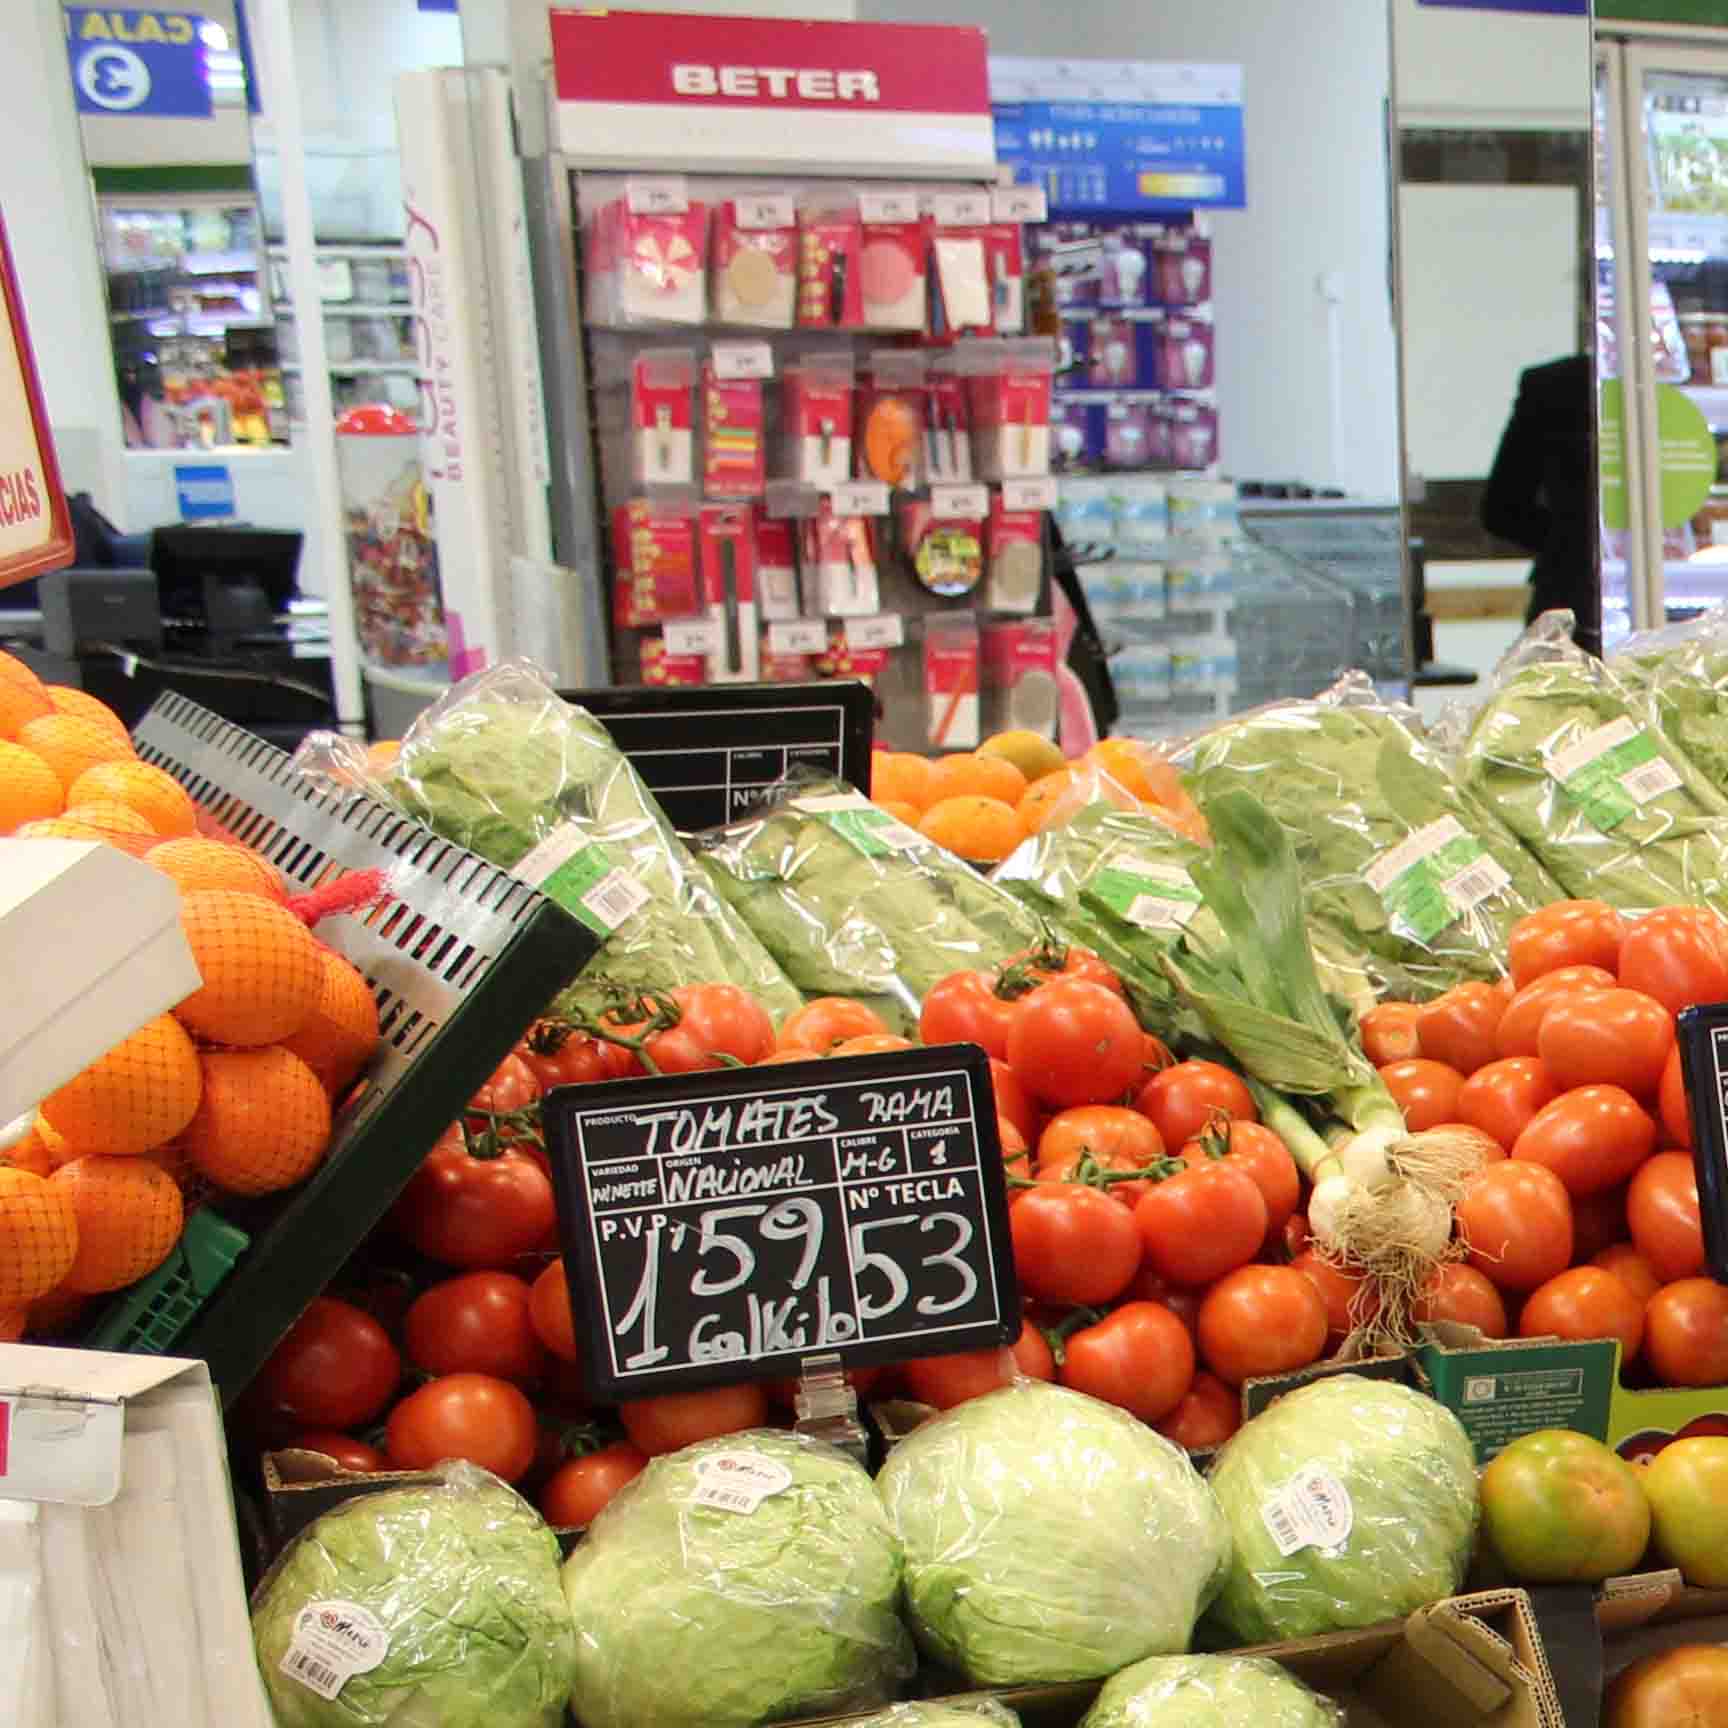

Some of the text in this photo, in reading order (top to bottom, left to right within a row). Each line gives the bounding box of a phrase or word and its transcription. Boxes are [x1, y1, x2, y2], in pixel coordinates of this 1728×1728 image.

[672, 65, 880, 101] BETER
[635, 1085, 955, 1154] TOMATES RAMA
[910, 1126, 960, 1139] CATEGORÍA
[840, 1136, 877, 1147] CALIBRE
[592, 1164, 639, 1177] VARIEDAD
[665, 1157, 701, 1168] ORIGEN
[666, 1154, 813, 1202] NACIONAL
[888, 1178, 965, 1205] TECLA
[600, 1214, 678, 1241] P.V.P.
[850, 1212, 978, 1320] 53
